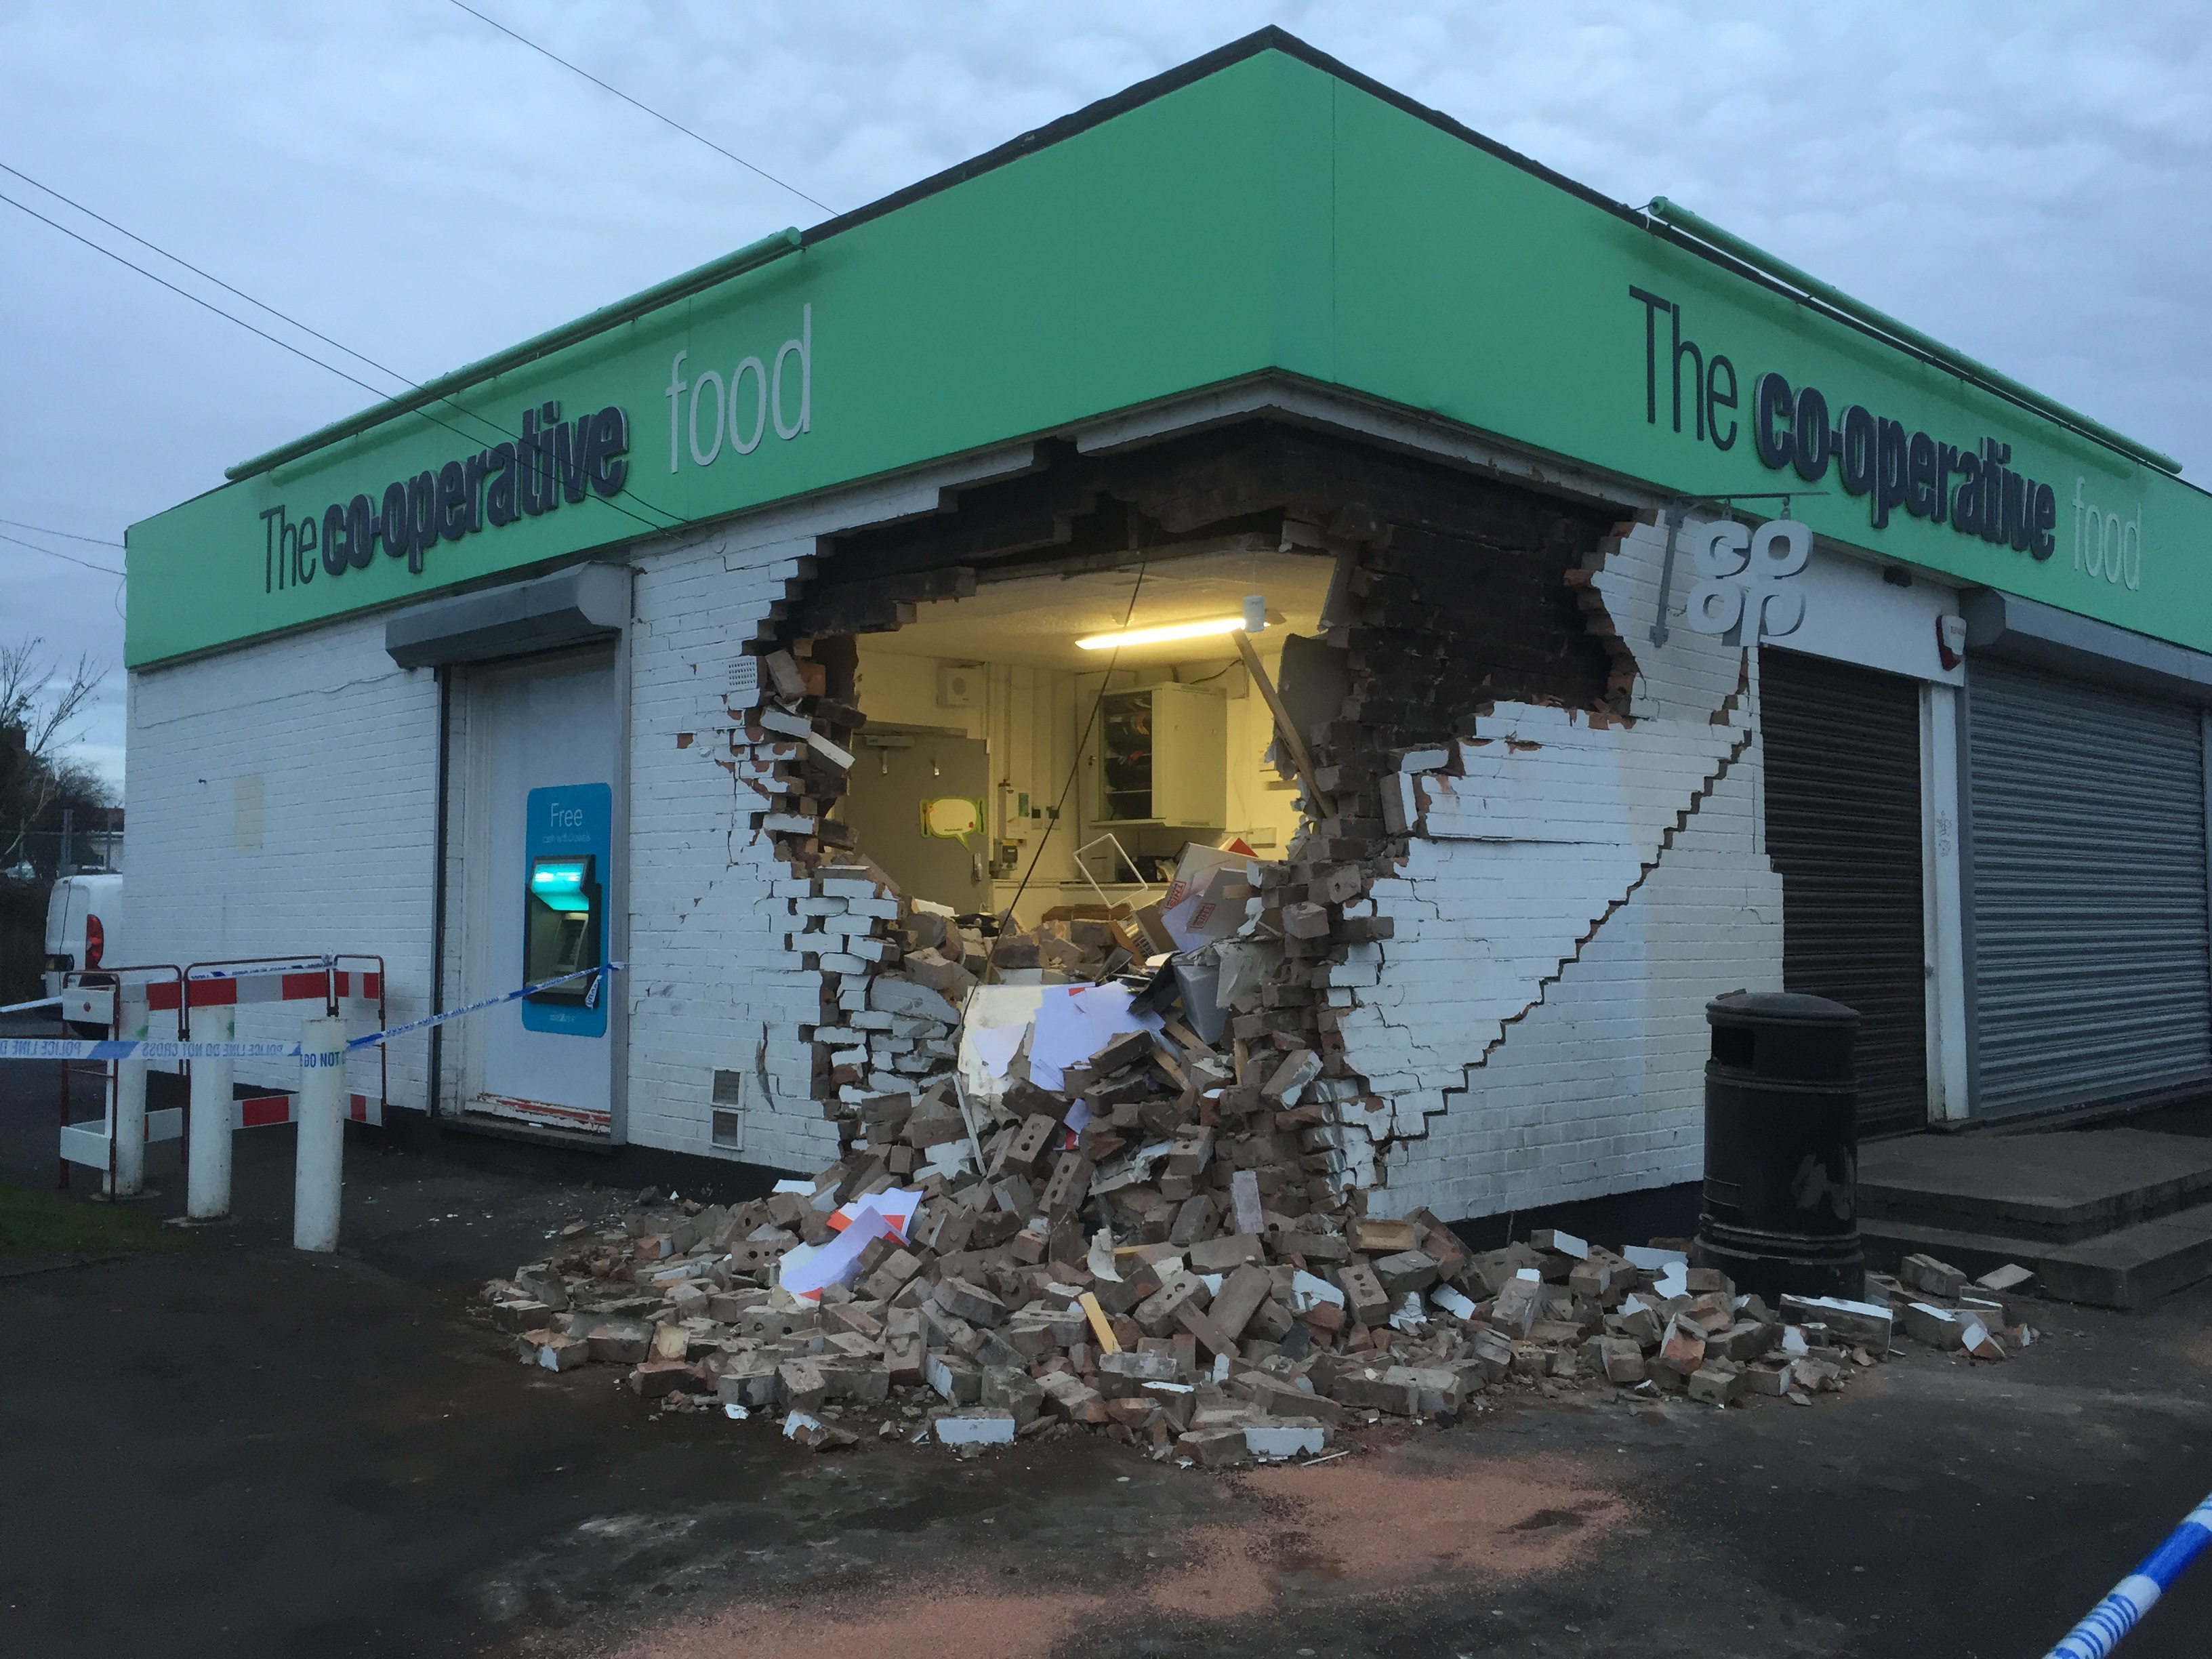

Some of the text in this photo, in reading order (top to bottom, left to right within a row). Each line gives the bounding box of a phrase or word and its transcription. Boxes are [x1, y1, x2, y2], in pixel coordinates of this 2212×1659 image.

[260, 302, 812, 594] The co-operative food
[1629, 284, 2144, 591] The co-operative food
[1687, 581, 1807, 647] op
[550, 802, 583, 827] Free
[1169, 884, 1184, 907] THIS
[1196, 905, 1213, 927] THIS
[304, 1052, 316, 1068] DO
[320, 1051, 340, 1067] NOT
